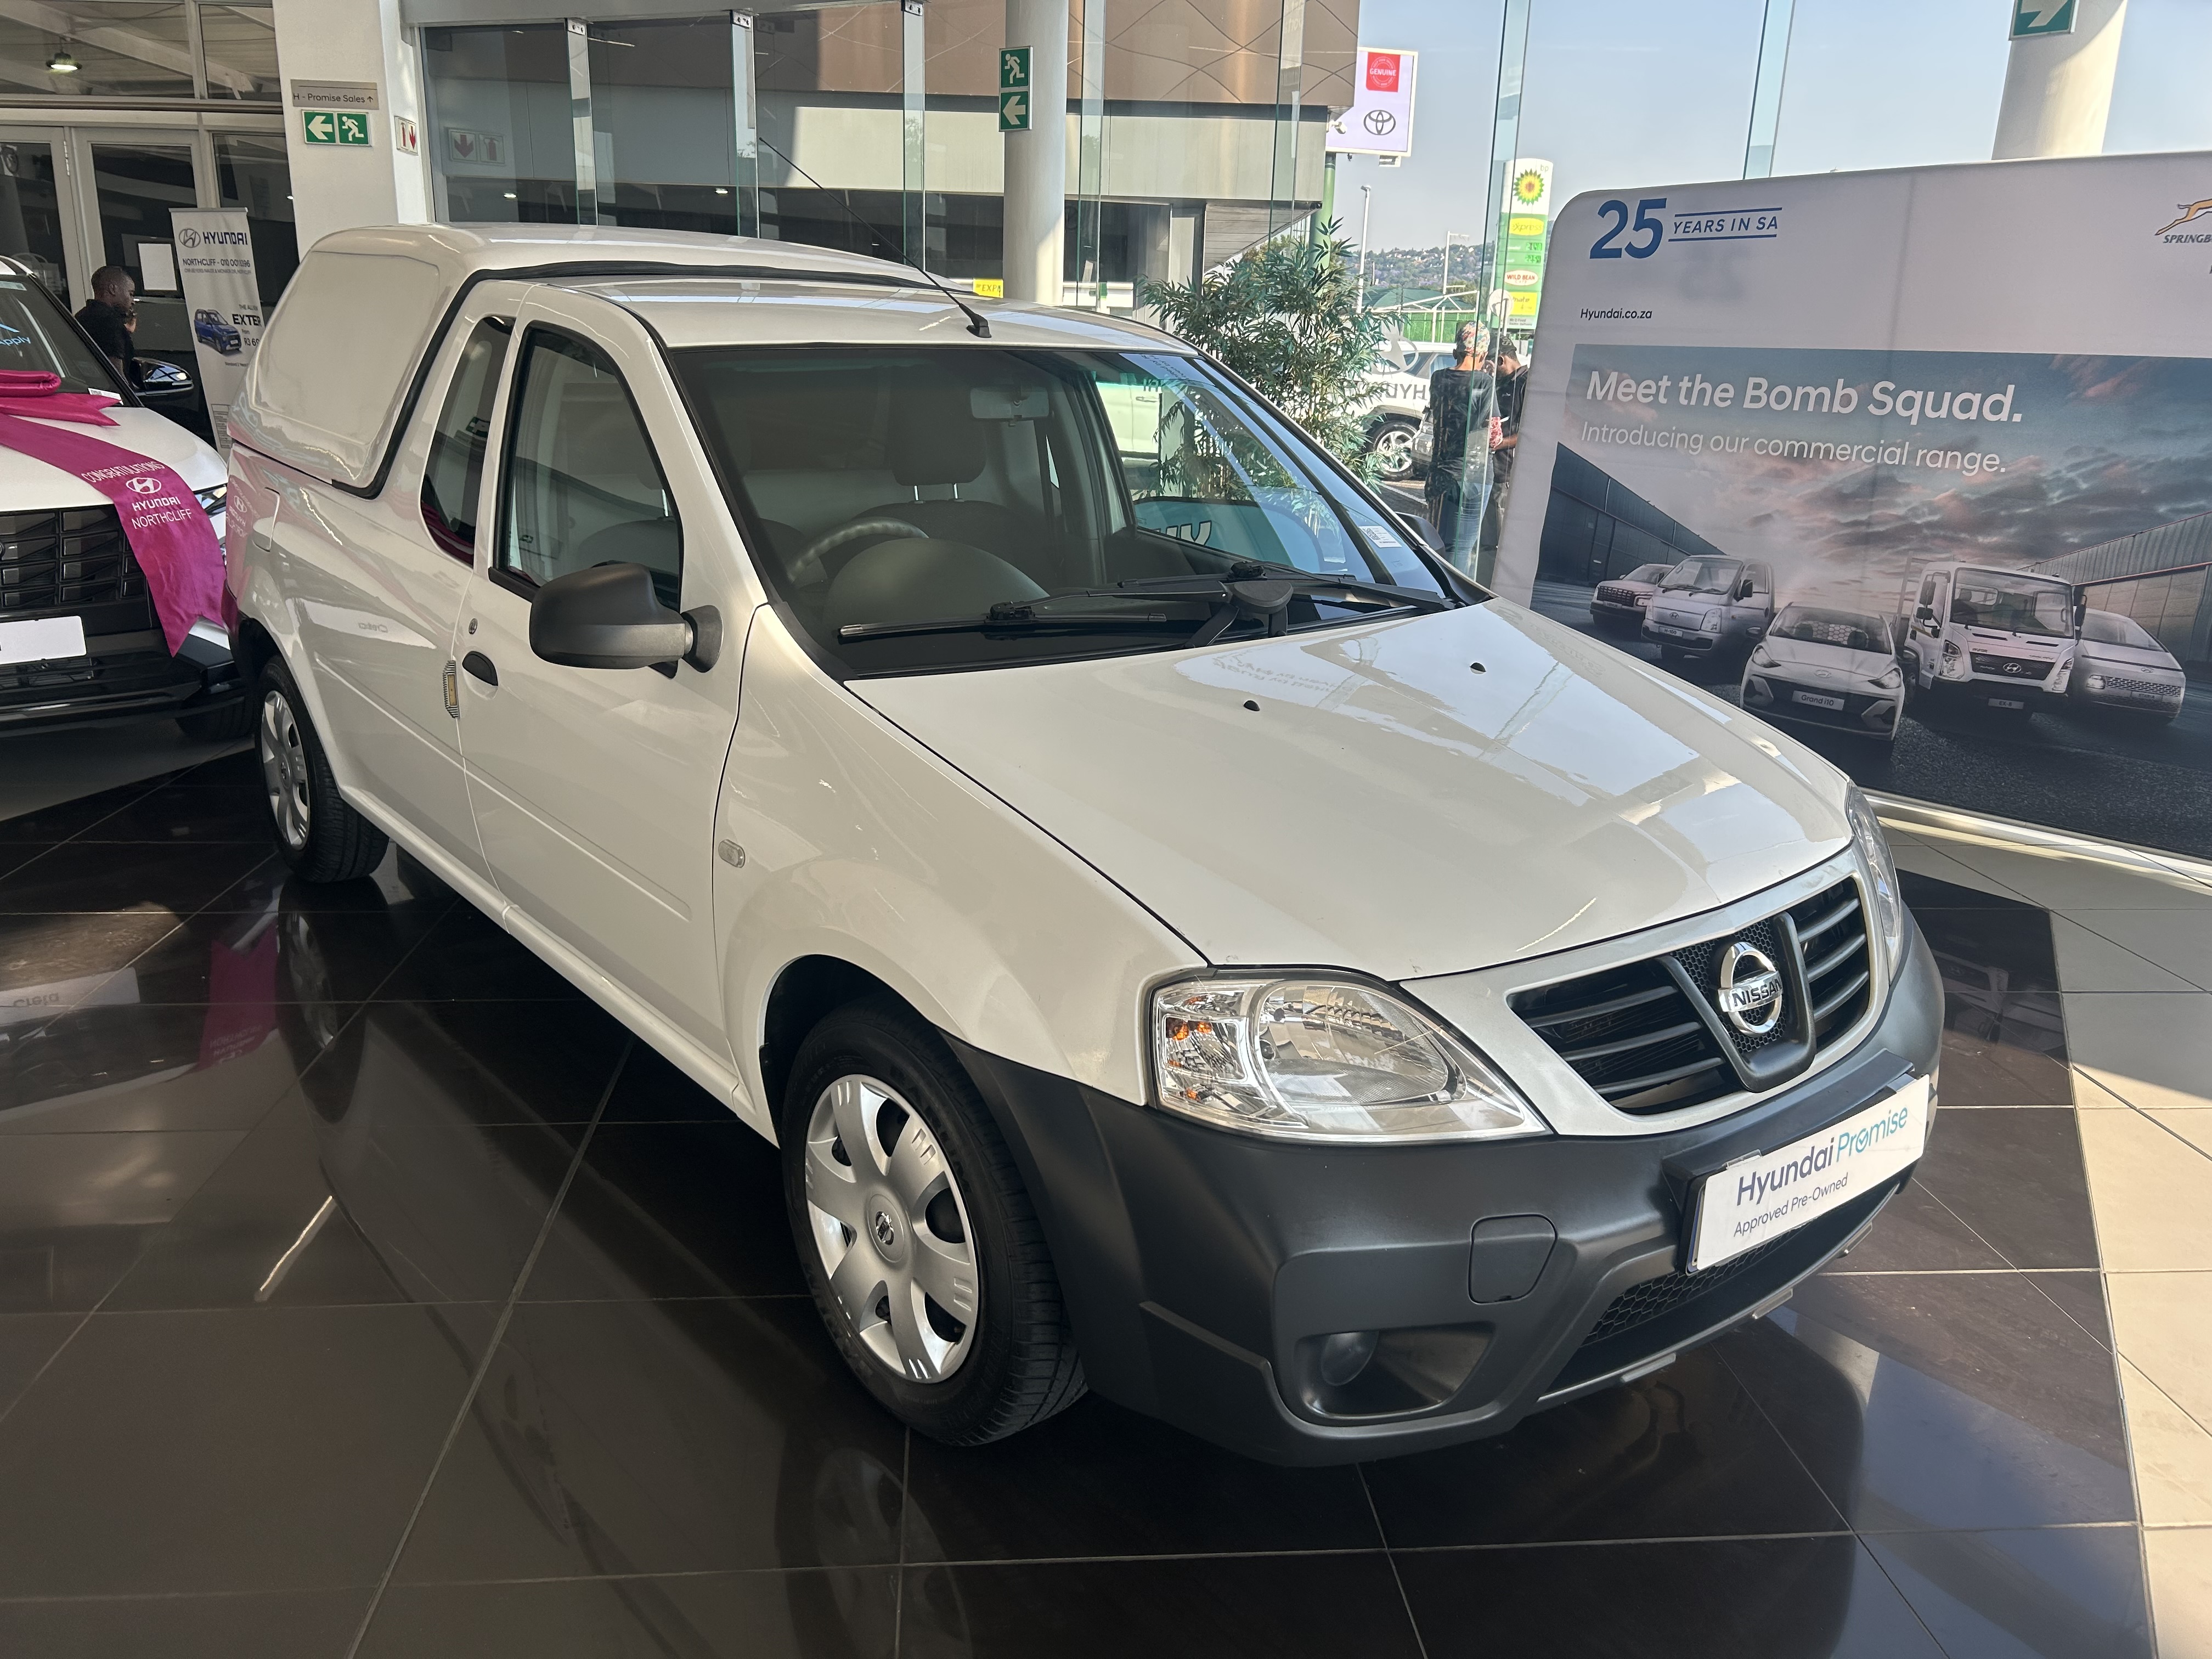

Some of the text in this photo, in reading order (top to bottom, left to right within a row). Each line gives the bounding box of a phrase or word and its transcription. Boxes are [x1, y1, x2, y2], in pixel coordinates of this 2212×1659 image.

[1369, 68, 1397, 76] GENUINE
[307, 93, 341, 101] Promise
[1589, 198, 1667, 259] 25
[1673, 216, 1778, 234] YEARS IN SA
[202, 232, 248, 245] HYUNDAI
[2163, 234, 2212, 243] SPRINGB
[1581, 308, 1652, 320] Hyundai.co.za
[1586, 371, 2022, 425] Meet the Bomb Squad.
[1581, 421, 2006, 476] Introducing our commercial range.
[81, 461, 166, 483] CONGRATULATIONS
[132, 496, 181, 511] HYUNDAI
[131, 508, 192, 529] NORTHCLIFF
[1801, 695, 1834, 706] Grand i10
[1732, 978, 1782, 1007] NISSAN
[1736, 1107, 1908, 1206] Hyundai Promise
[1734, 1172, 1849, 1238] Approved Pre-Owned
